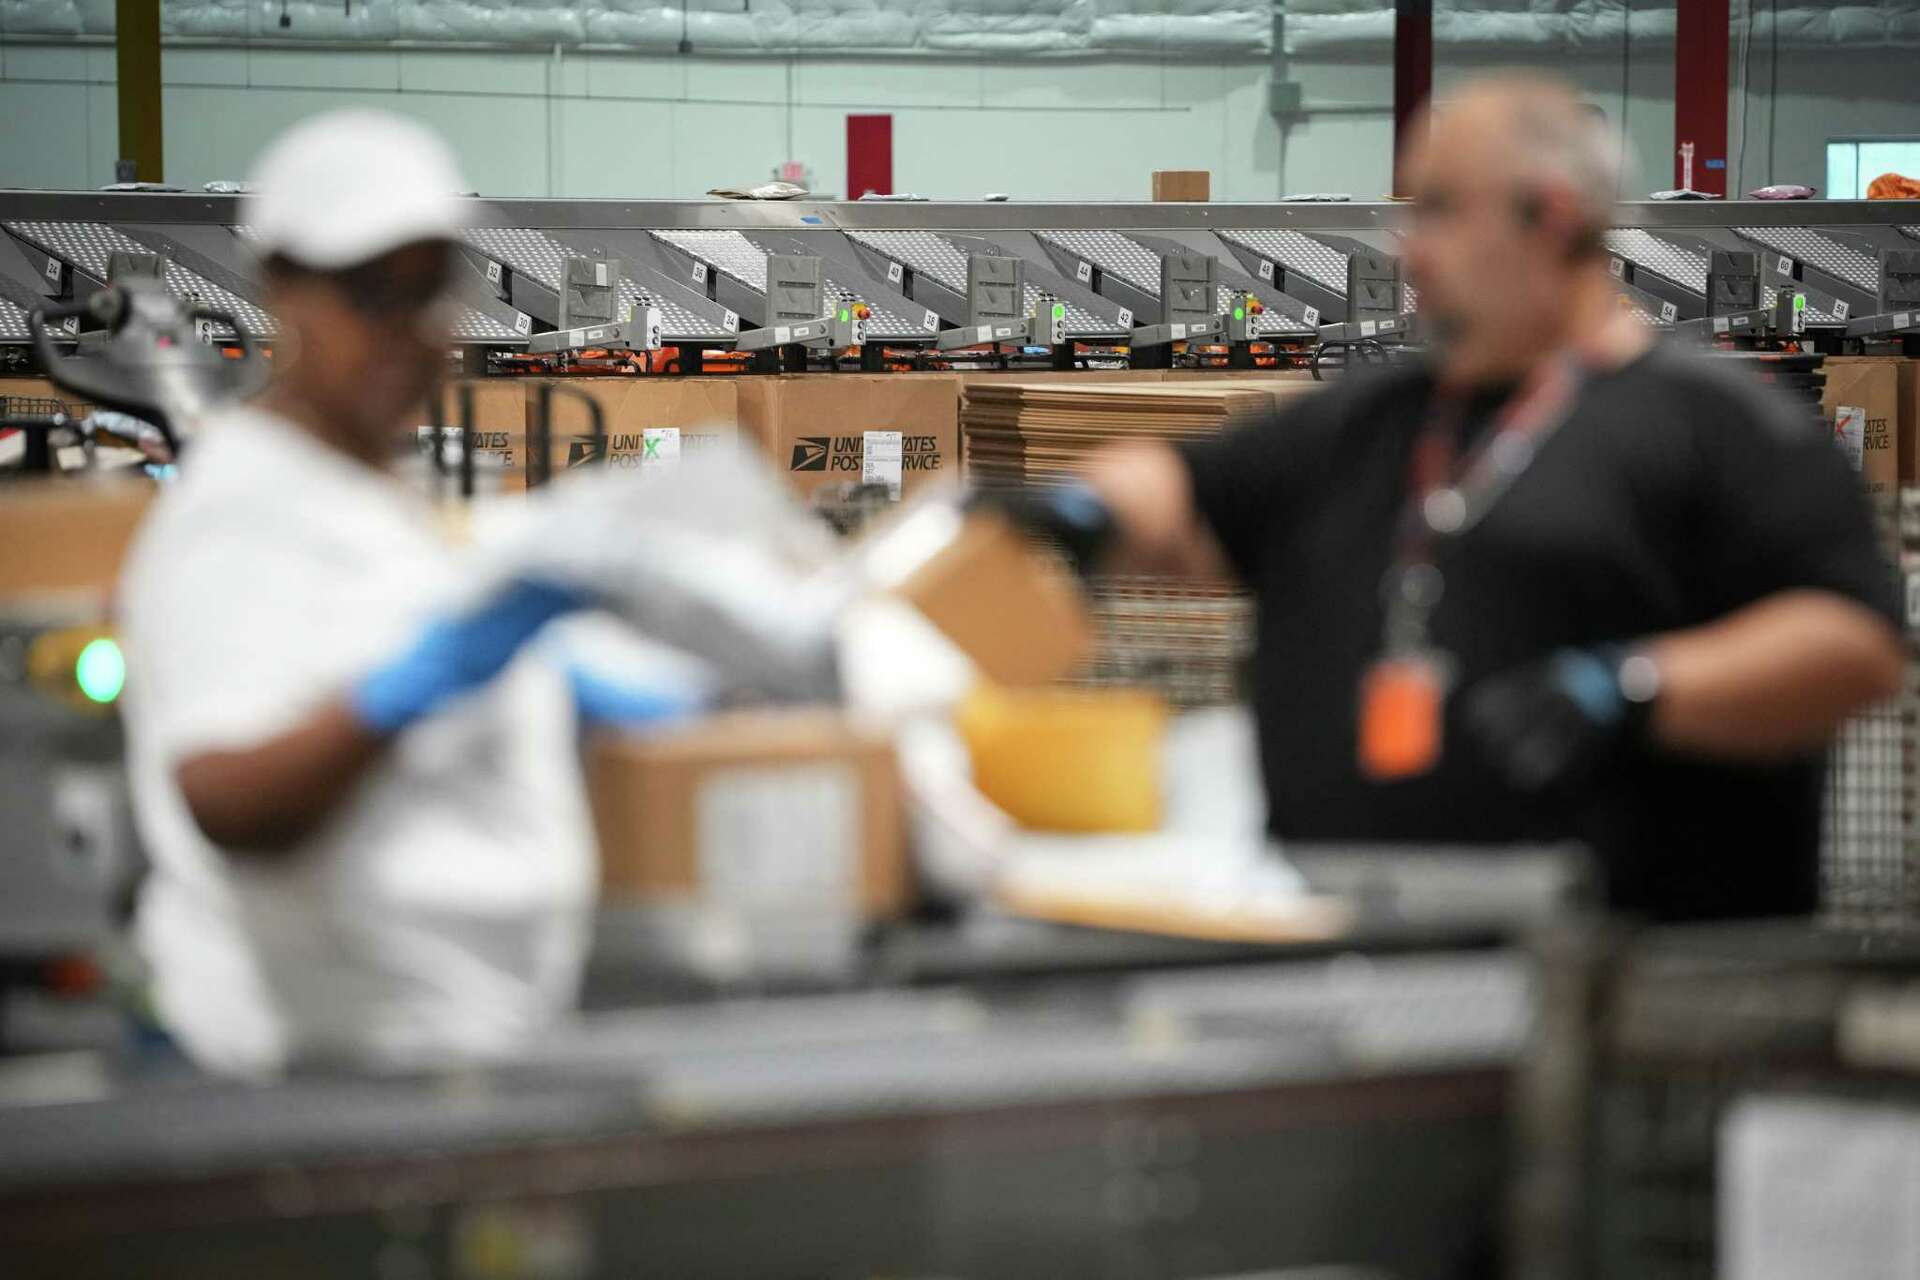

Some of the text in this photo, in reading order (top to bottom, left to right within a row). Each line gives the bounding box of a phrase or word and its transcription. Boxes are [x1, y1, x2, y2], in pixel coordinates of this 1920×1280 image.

[48, 263, 58, 275] 24
[488, 265, 498, 278] 32
[1079, 266, 1089, 277] 44
[1780, 260, 1790, 271] 60
[890, 268, 899, 279] 40
[1664, 305, 1673, 317] 54
[518, 316, 528, 328] 30
[725, 315, 735, 327] 34
[1120, 312, 1130, 323] 42
[1864, 418, 1888, 433] ATES
[613, 434, 643, 451] UNI
[834, 436, 937, 452] UNI ATES
[830, 455, 863, 471] POS
[902, 454, 942, 471] RVICE
